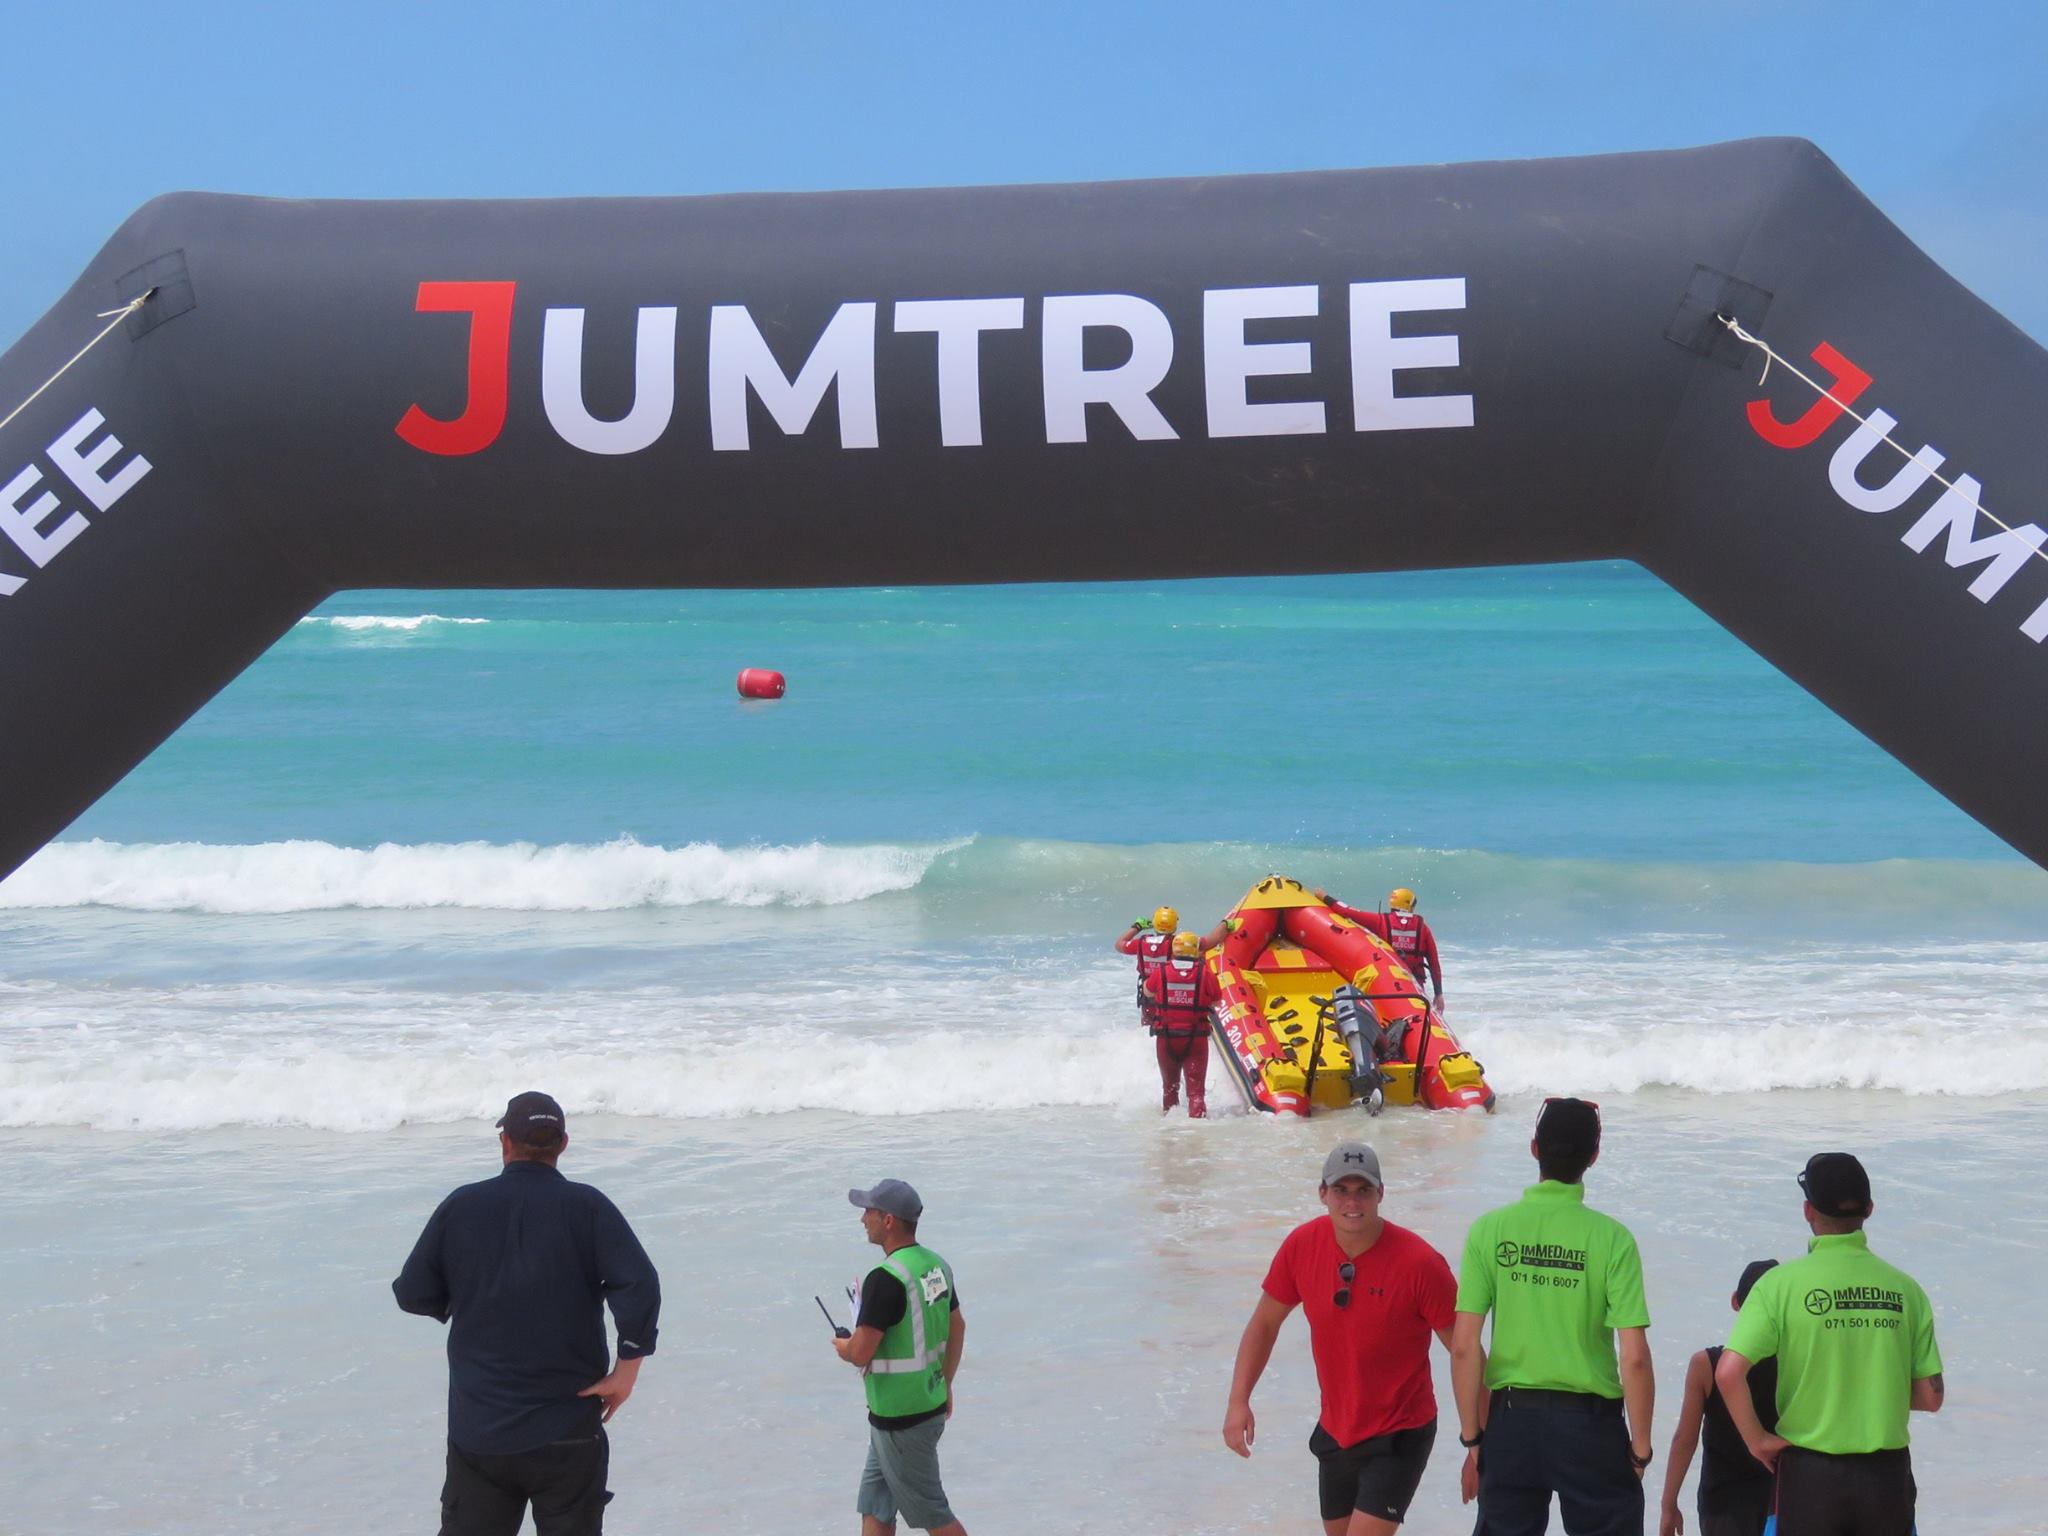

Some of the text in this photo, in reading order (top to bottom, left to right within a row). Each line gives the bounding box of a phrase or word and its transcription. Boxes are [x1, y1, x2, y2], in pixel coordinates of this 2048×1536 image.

[395, 277, 1475, 456] JUMTREE
[0, 407, 153, 597] EE
[1167, 996, 1195, 1004] RESCUE
[1511, 1271, 1580, 1289] 071 501 6007
[1838, 1302, 1900, 1311] MEDICAL
[1825, 1317, 1901, 1330] 071 501 6007
